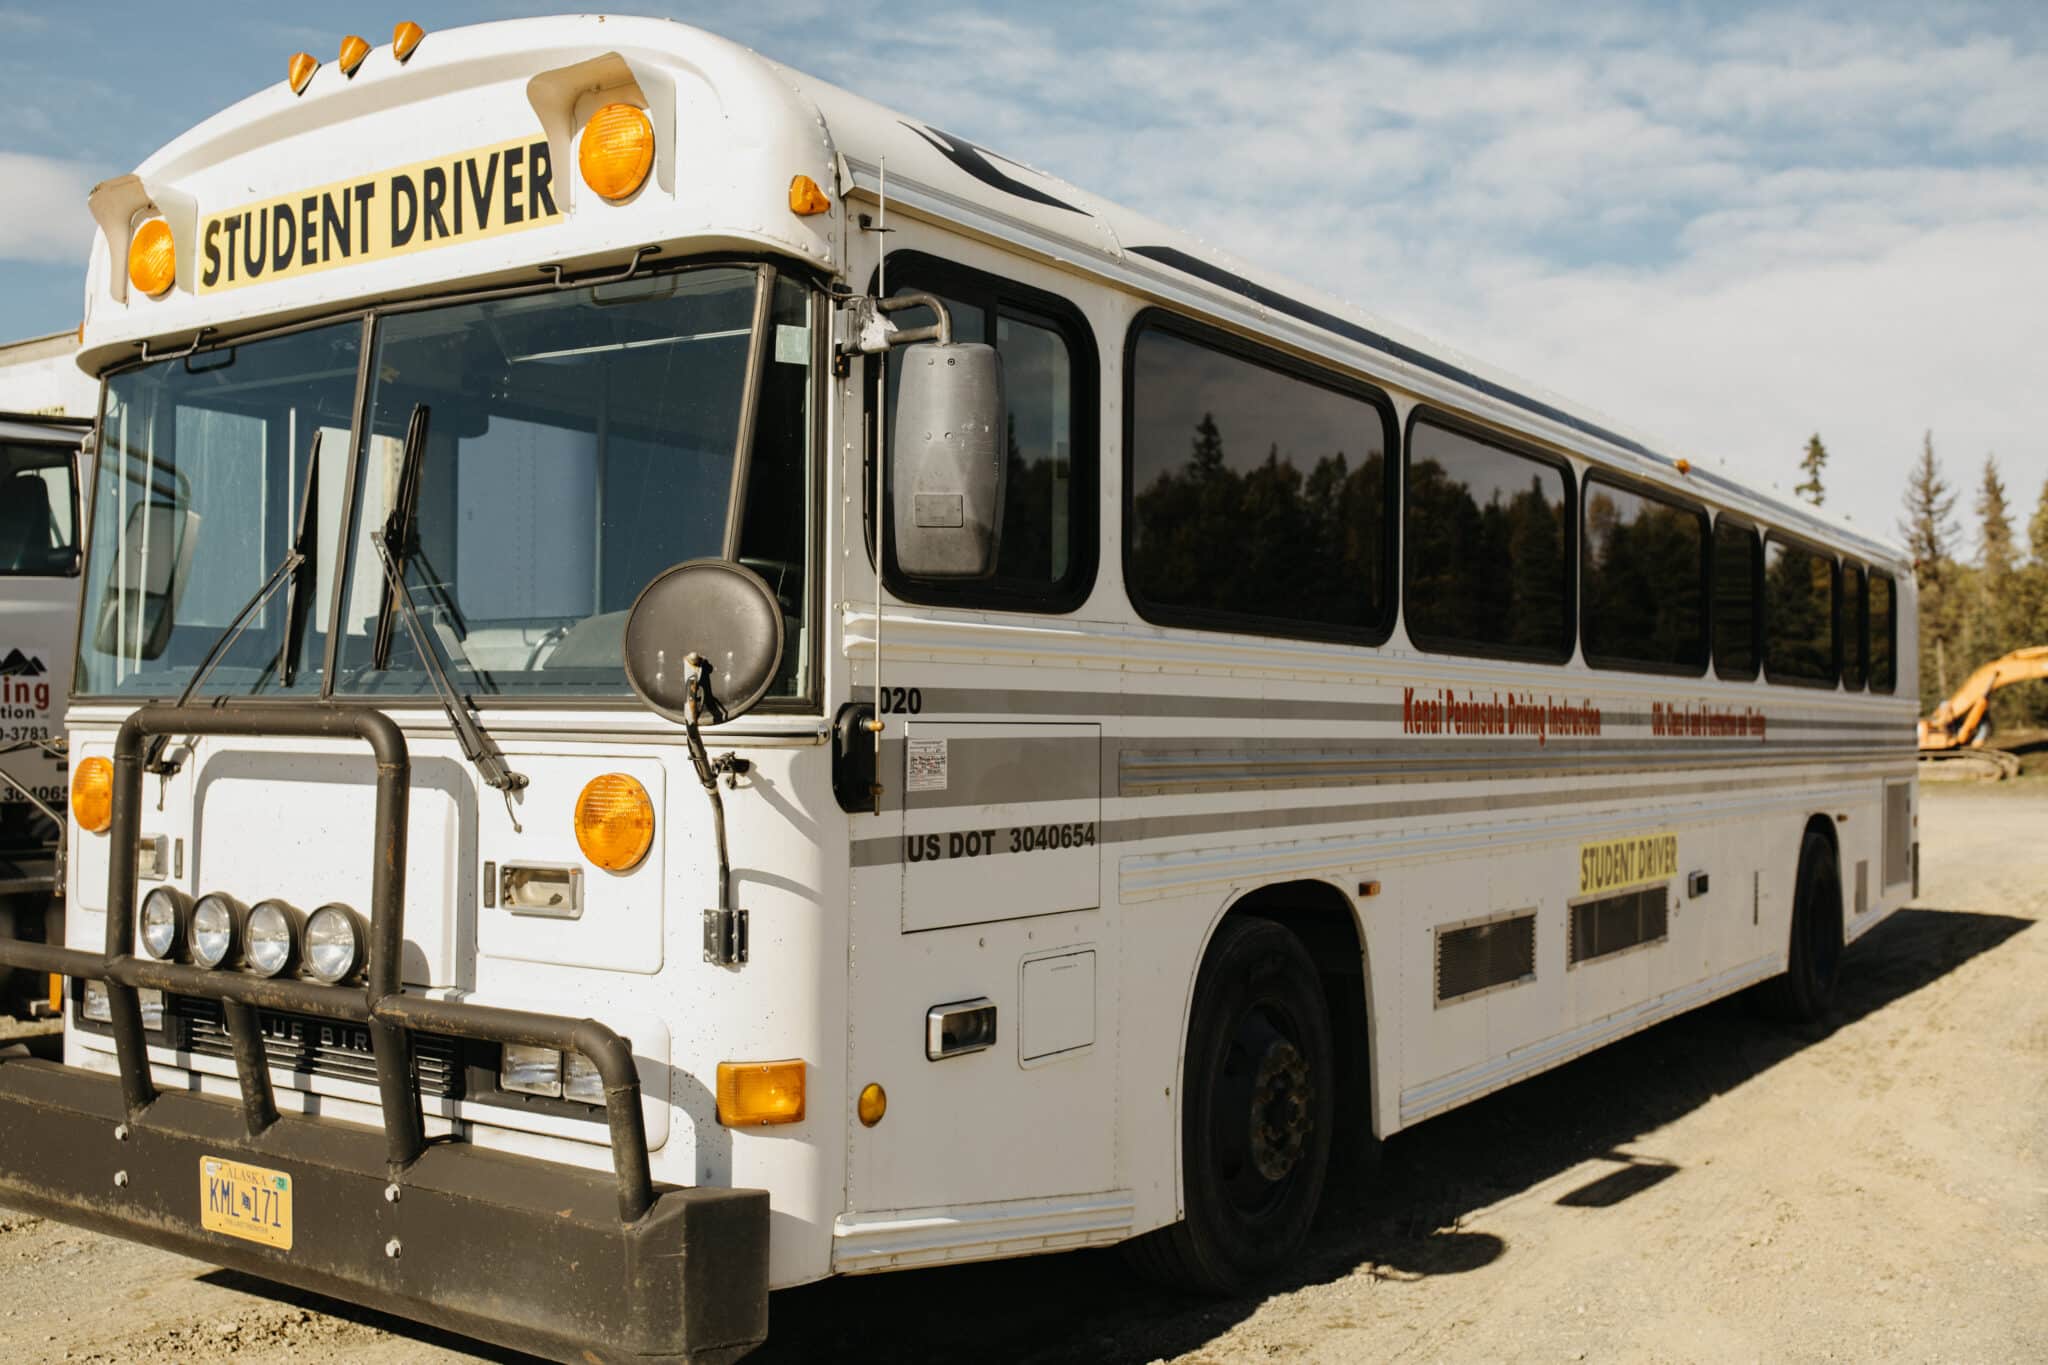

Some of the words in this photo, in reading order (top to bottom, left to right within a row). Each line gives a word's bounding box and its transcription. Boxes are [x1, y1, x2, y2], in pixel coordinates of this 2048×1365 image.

[202, 181, 376, 287] STUDENT
[391, 141, 558, 248] DRIVER
[1404, 686, 1442, 734] Kenai
[1446, 688, 1505, 735] Peninsula
[1508, 692, 1545, 746] Driving
[907, 834, 941, 862] US
[950, 830, 996, 858] DOT
[1009, 821, 1096, 853] 3040654
[1581, 841, 1636, 892] STUDENT
[1638, 835, 1678, 880] DRIVER
[209, 1176, 240, 1217] KML
[251, 1185, 282, 1228] 171
[226, 1166, 268, 1187] ALASKA
